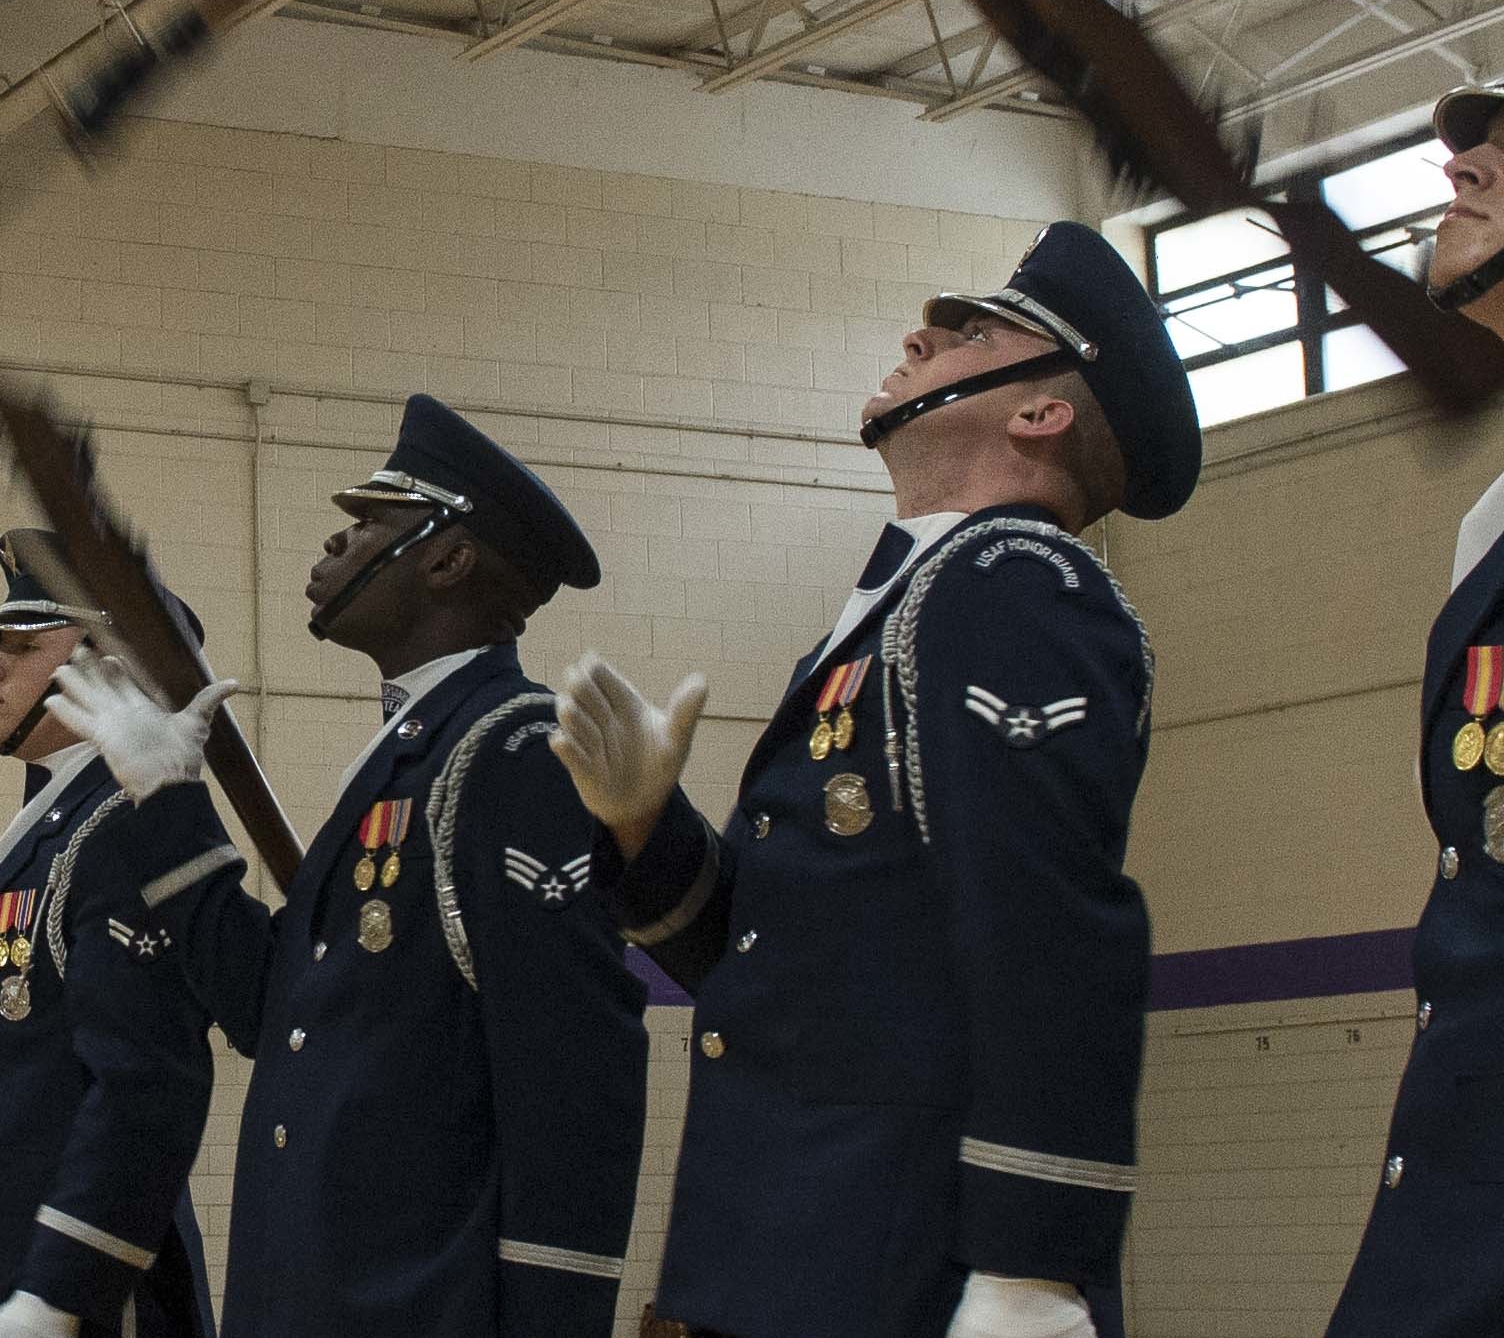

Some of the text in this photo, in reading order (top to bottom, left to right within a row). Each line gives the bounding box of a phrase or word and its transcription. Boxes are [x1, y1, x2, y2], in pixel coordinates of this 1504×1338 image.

[975, 538, 1080, 589] USAF HONOR GUARD
